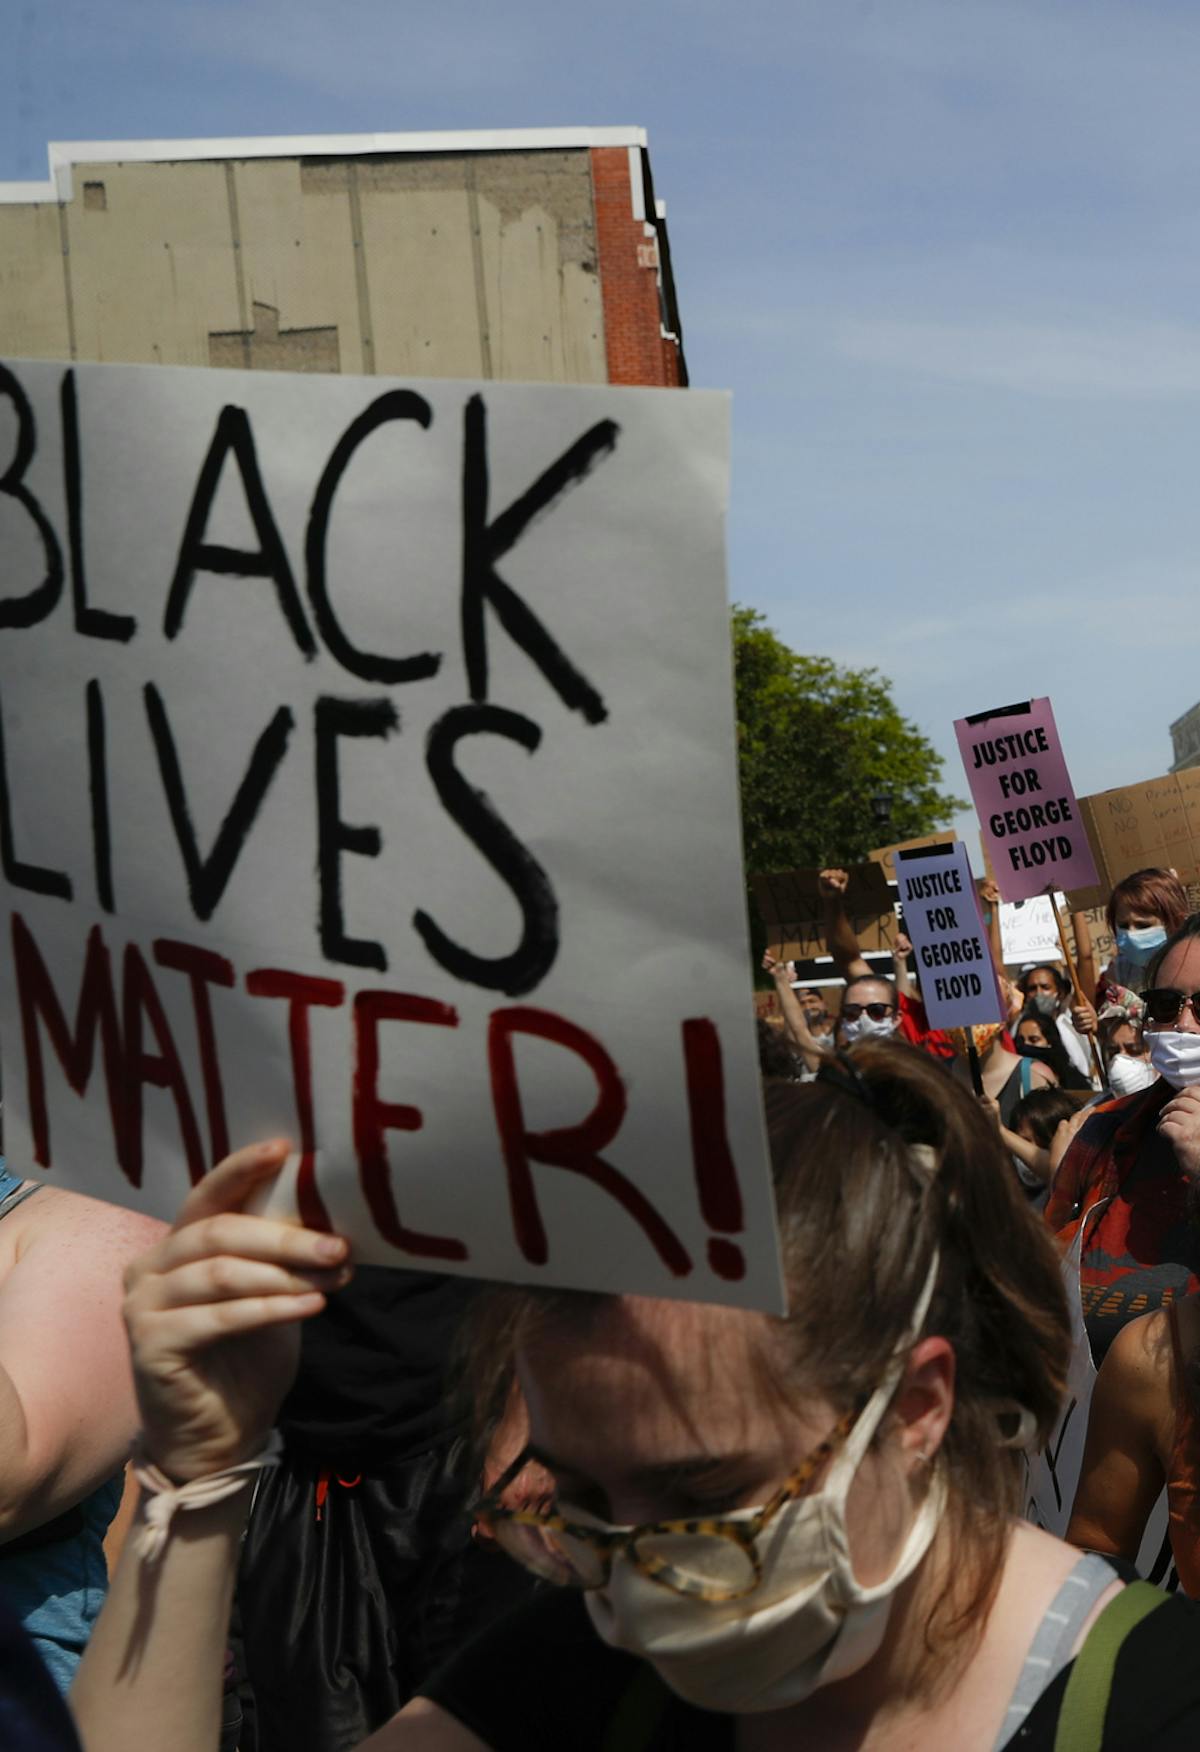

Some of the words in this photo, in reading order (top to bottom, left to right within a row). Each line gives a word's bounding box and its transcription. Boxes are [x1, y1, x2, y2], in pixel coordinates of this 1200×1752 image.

[0, 362, 620, 725] BLACK
[972, 727, 1050, 769] JUSTICE
[999, 767, 1043, 799] FOR
[989, 796, 1073, 839] GEORGE
[0, 677, 560, 997] LIVES
[1007, 834, 1073, 872] FLOYD
[905, 868, 963, 901] JUSTICE
[926, 906, 960, 933] FOR
[920, 936, 983, 969] GEORGE
[934, 970, 982, 1002] FLOYD
[11, 910, 748, 1282] MATTER!
